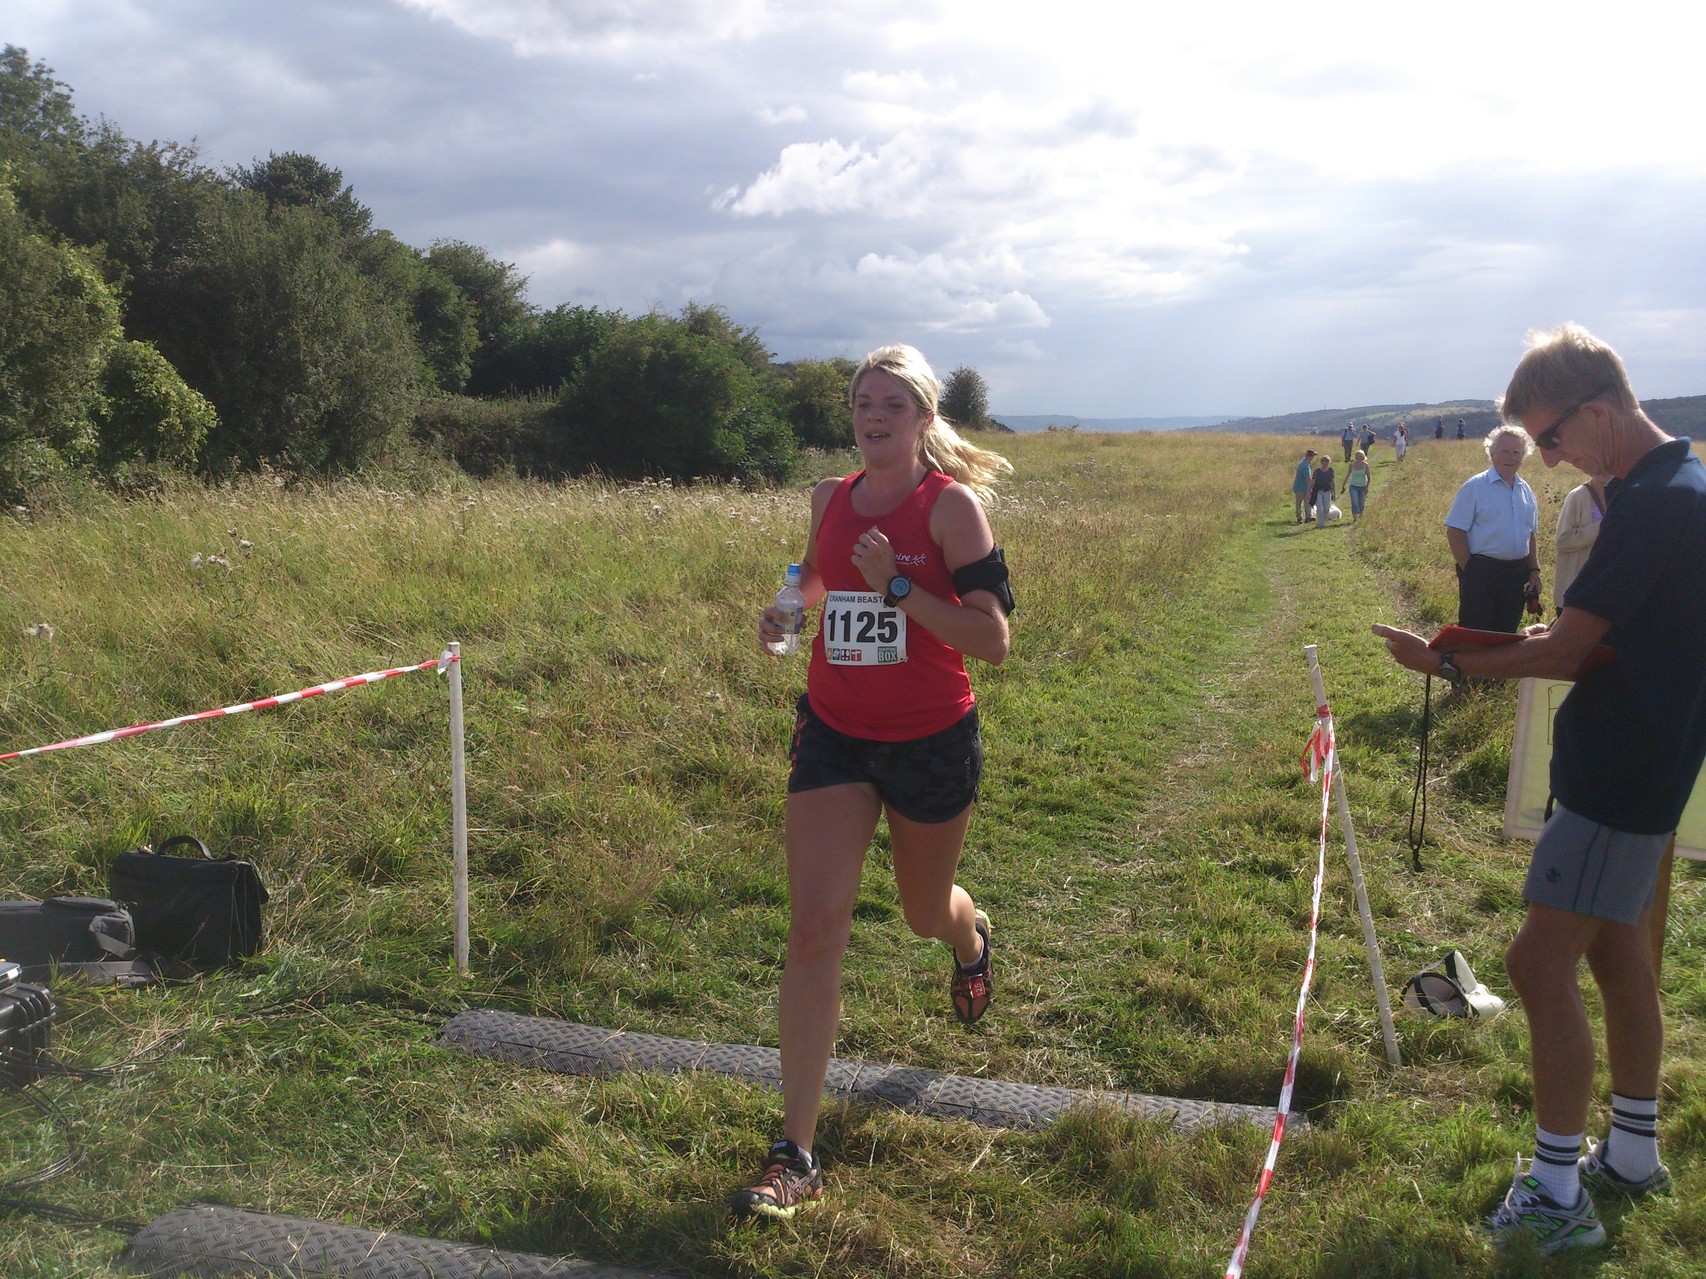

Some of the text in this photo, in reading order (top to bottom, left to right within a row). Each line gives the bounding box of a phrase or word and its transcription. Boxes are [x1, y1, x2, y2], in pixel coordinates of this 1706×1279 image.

[829, 594, 856, 603] CRANHAM
[828, 610, 898, 643] 1125
[878, 651, 896, 661] BOX
